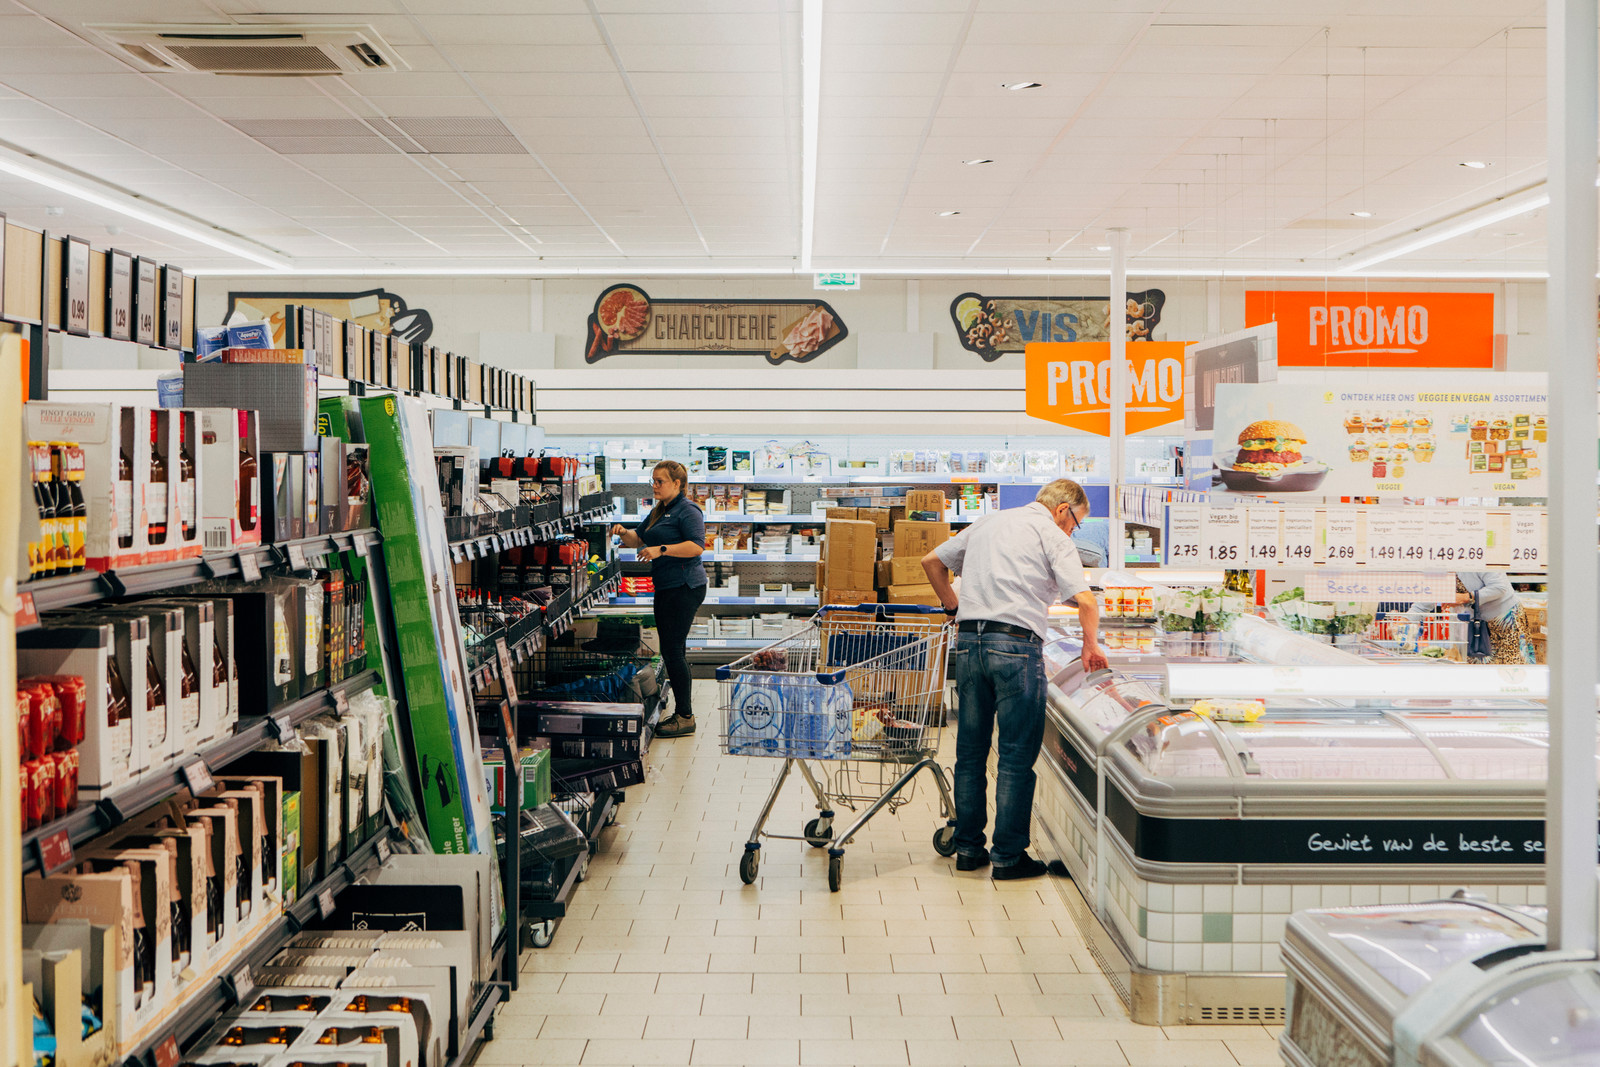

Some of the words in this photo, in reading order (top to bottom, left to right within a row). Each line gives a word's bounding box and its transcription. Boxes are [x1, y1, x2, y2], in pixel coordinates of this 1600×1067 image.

[72, 299, 85, 320] 0.99
[655, 314, 777, 340] CHARCUTERIE
[1013, 309, 1078, 343] VIS
[1309, 305, 1429, 346] PROMO
[1341, 393, 1374, 402] ONTDEK
[1376, 393, 1396, 402] HIER
[1398, 394, 1415, 402] ONS
[1419, 394, 1449, 402] VEGGIE
[1451, 394, 1461, 402] EN
[1463, 394, 1490, 402] VEGAN
[1494, 394, 1548, 403] ASSORTIMEN
[1376, 483, 1401, 491] VEGGIE
[1494, 483, 1516, 491] VEGAN
[1173, 544, 1199, 557] 2.75
[1209, 545, 1238, 560] 1.85
[1251, 545, 1277, 558] 1.49
[1286, 545, 1312, 558] 1.49
[1328, 546, 1354, 559] 2.69
[1370, 546, 1395, 559] 1.49
[1398, 546, 1424, 560] 1.49
[1428, 547, 1454, 561] 1.49
[1458, 547, 1484, 560] 2.69
[1513, 548, 1538, 561] 2.69
[1327, 580, 1369, 594] Beste
[1378, 581, 1433, 595] selectie
[452, 817, 466, 855] ounger
[1308, 833, 1373, 851] Geniet
[1422, 833, 1449, 851] de
[1459, 833, 1514, 851] beste
